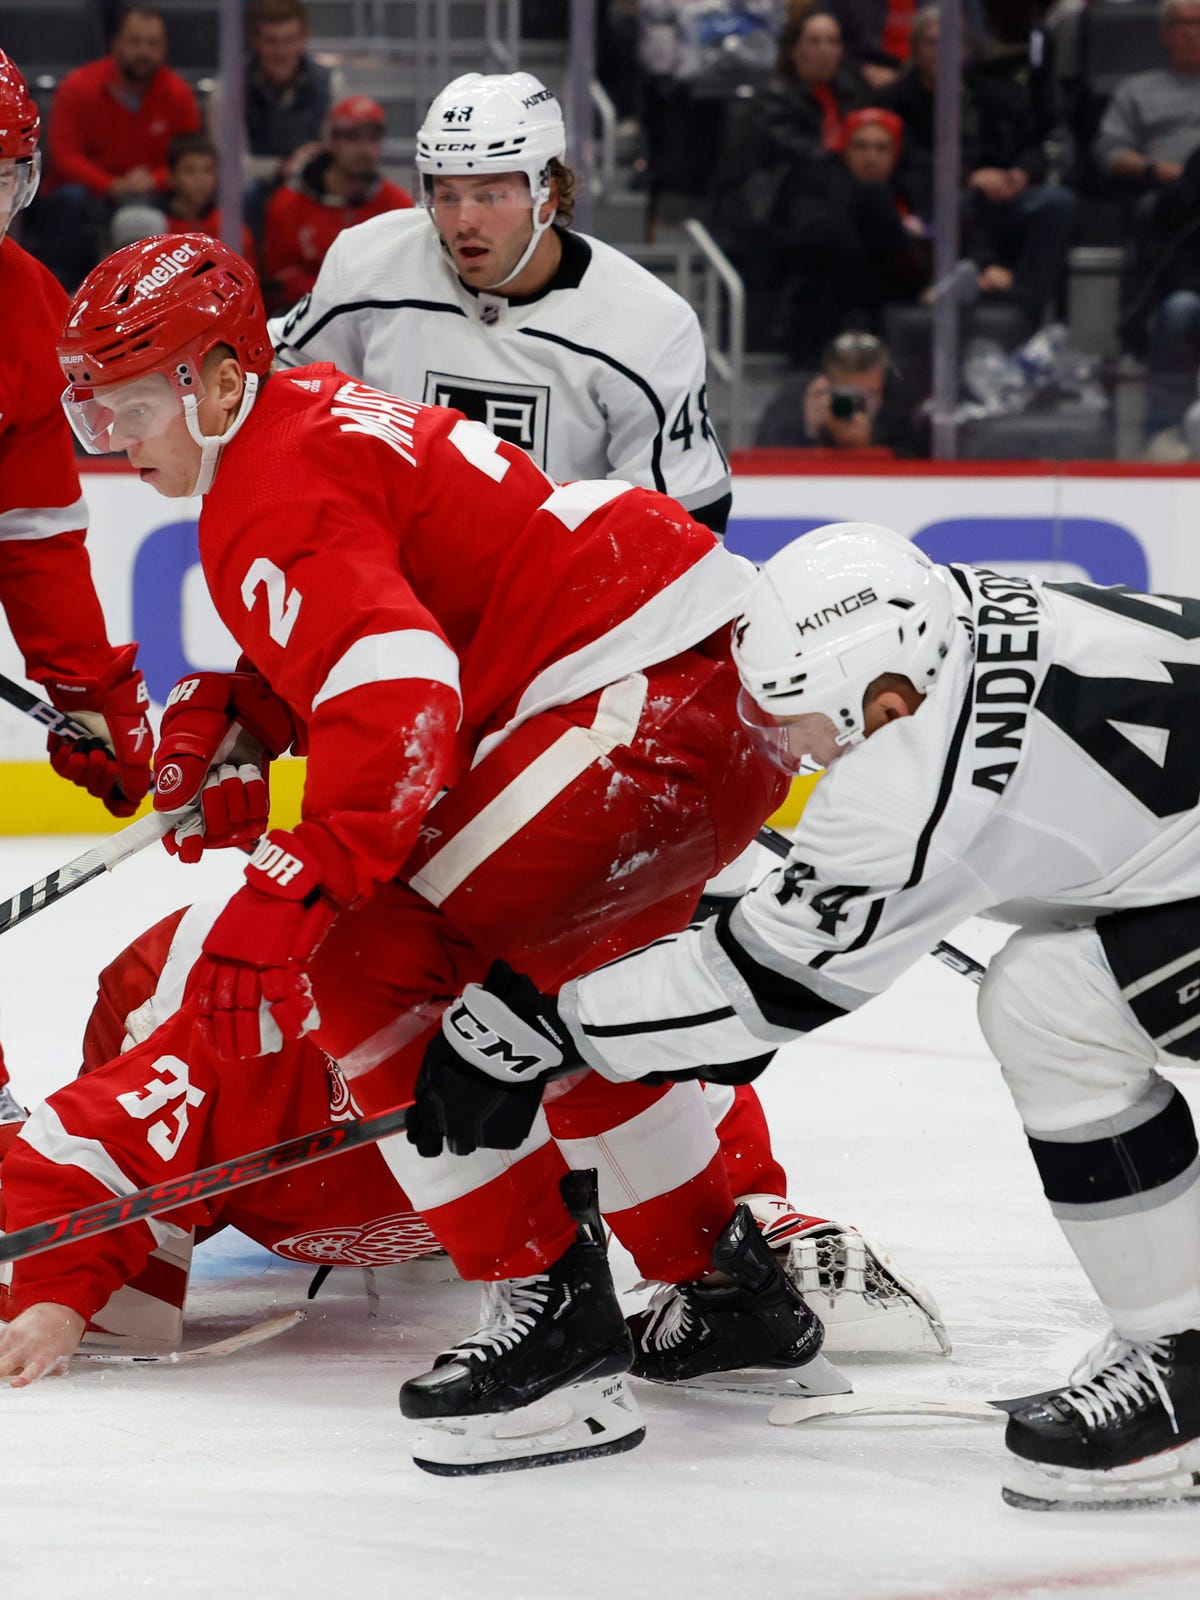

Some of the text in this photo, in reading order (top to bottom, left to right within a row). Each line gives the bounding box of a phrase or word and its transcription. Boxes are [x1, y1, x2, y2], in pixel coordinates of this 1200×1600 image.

[435, 143, 476, 151] CCM
[133, 242, 198, 298] meijer
[240, 557, 303, 648] 2
[796, 588, 878, 636] KINGS
[116, 1055, 206, 1162] 35
